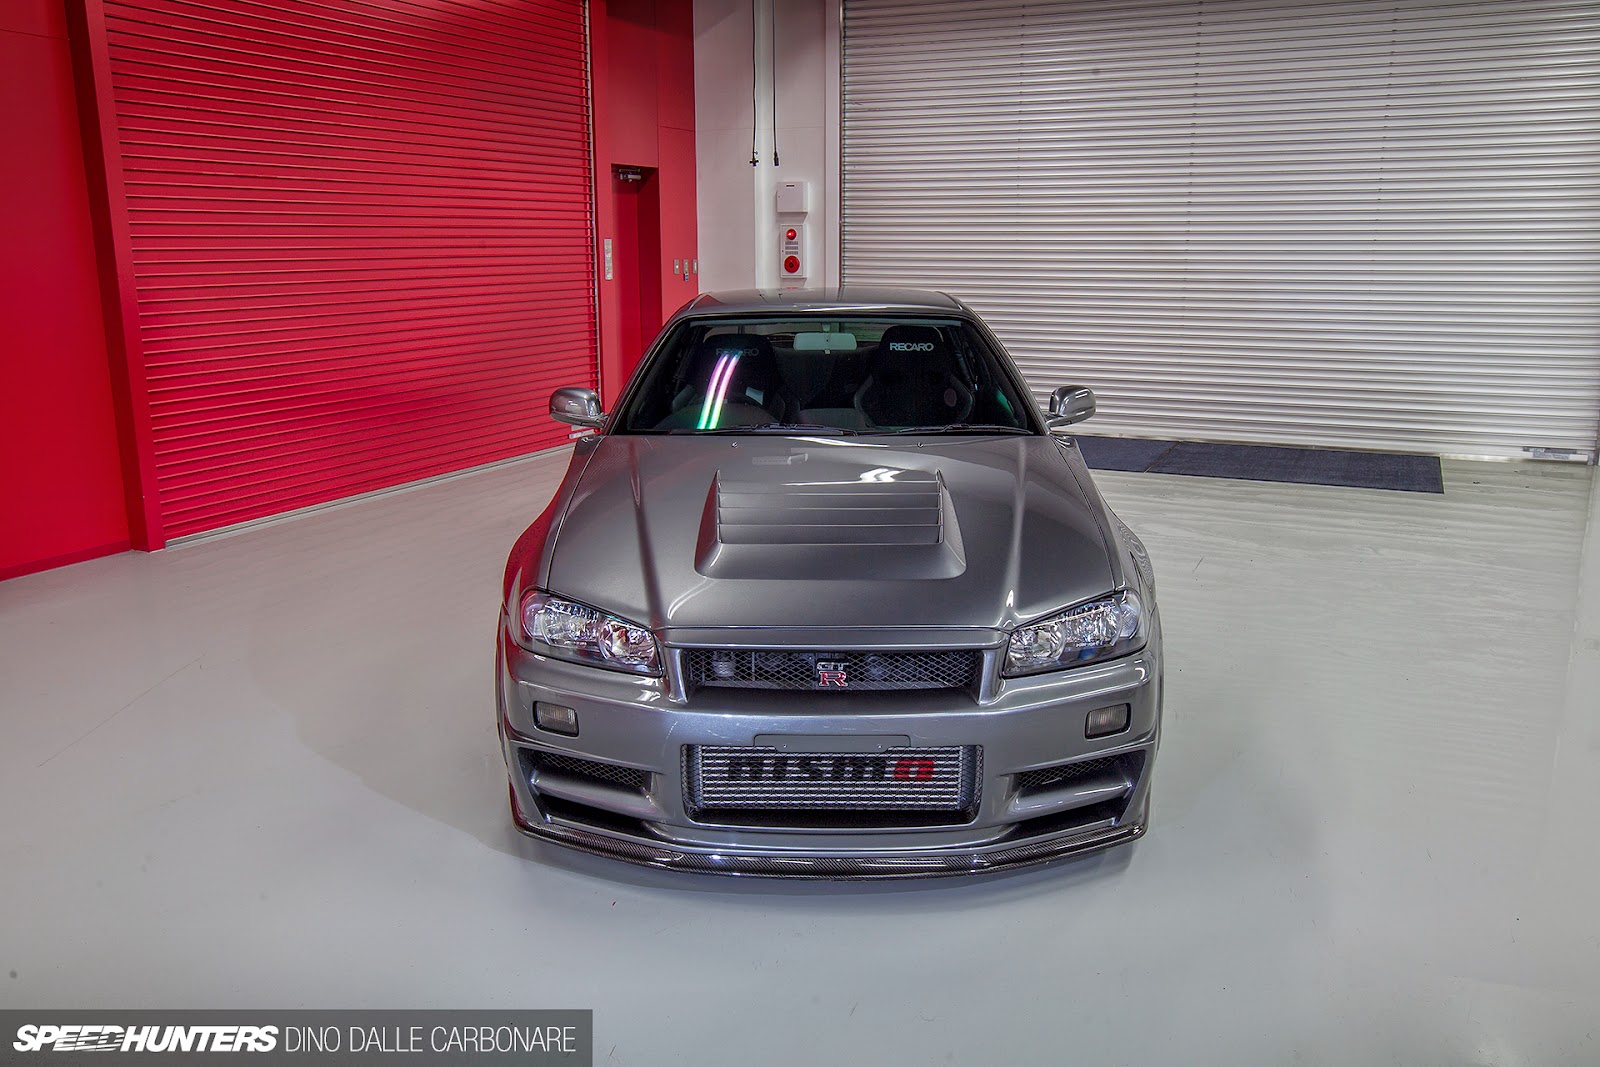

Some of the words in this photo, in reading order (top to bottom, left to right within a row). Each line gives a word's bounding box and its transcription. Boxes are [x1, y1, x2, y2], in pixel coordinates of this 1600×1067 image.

[715, 347, 760, 357] RECRO
[889, 342, 935, 352] RECARO
[818, 670, 849, 687] R
